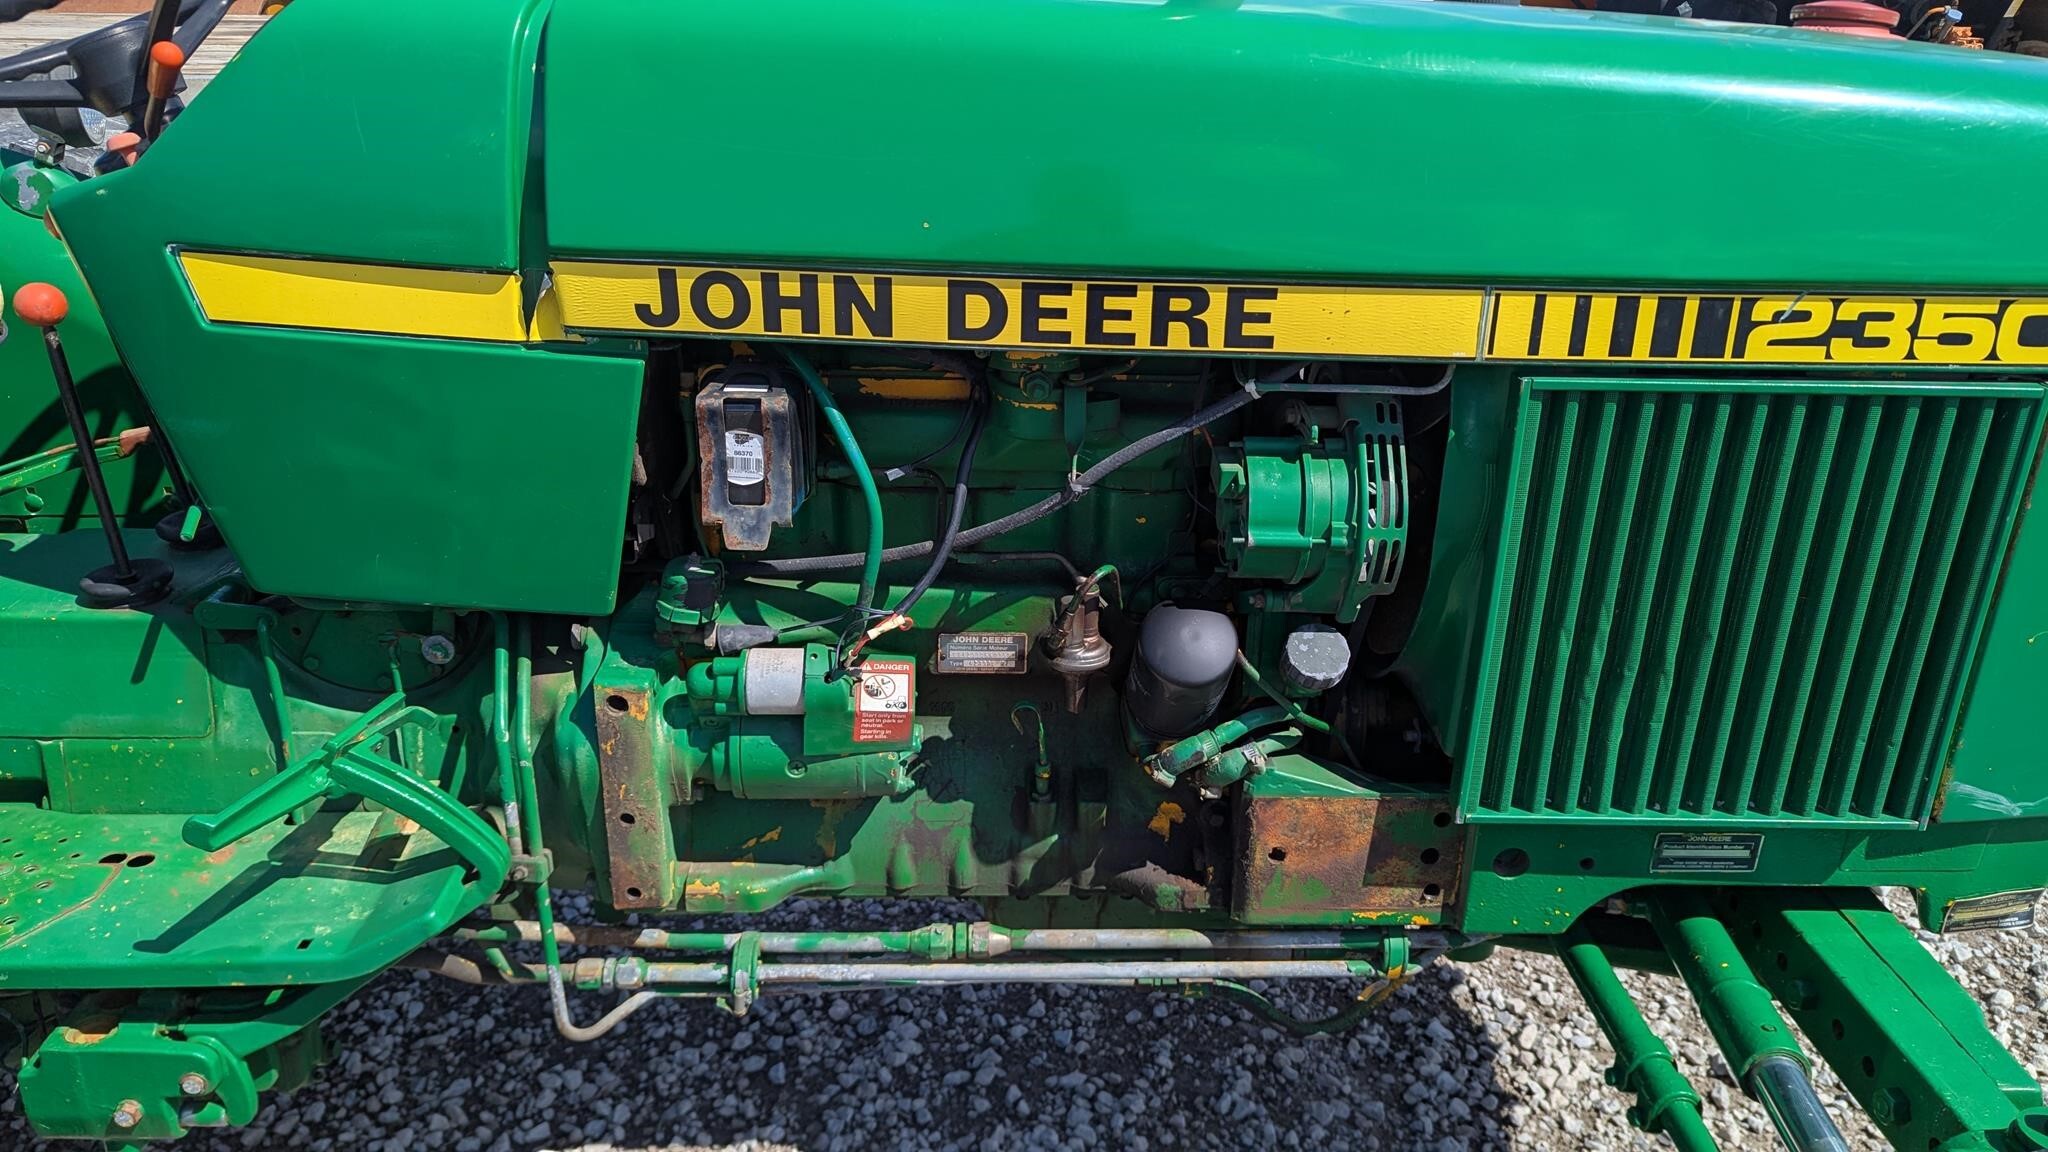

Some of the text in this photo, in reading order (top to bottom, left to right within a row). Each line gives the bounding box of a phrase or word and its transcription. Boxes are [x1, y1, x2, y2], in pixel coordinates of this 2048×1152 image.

[634, 268, 1277, 350] JOHN DEERE
[1744, 296, 2048, 363] 2350
[981, 636, 1014, 644] DEERE
[873, 663, 910, 671] DANGER
